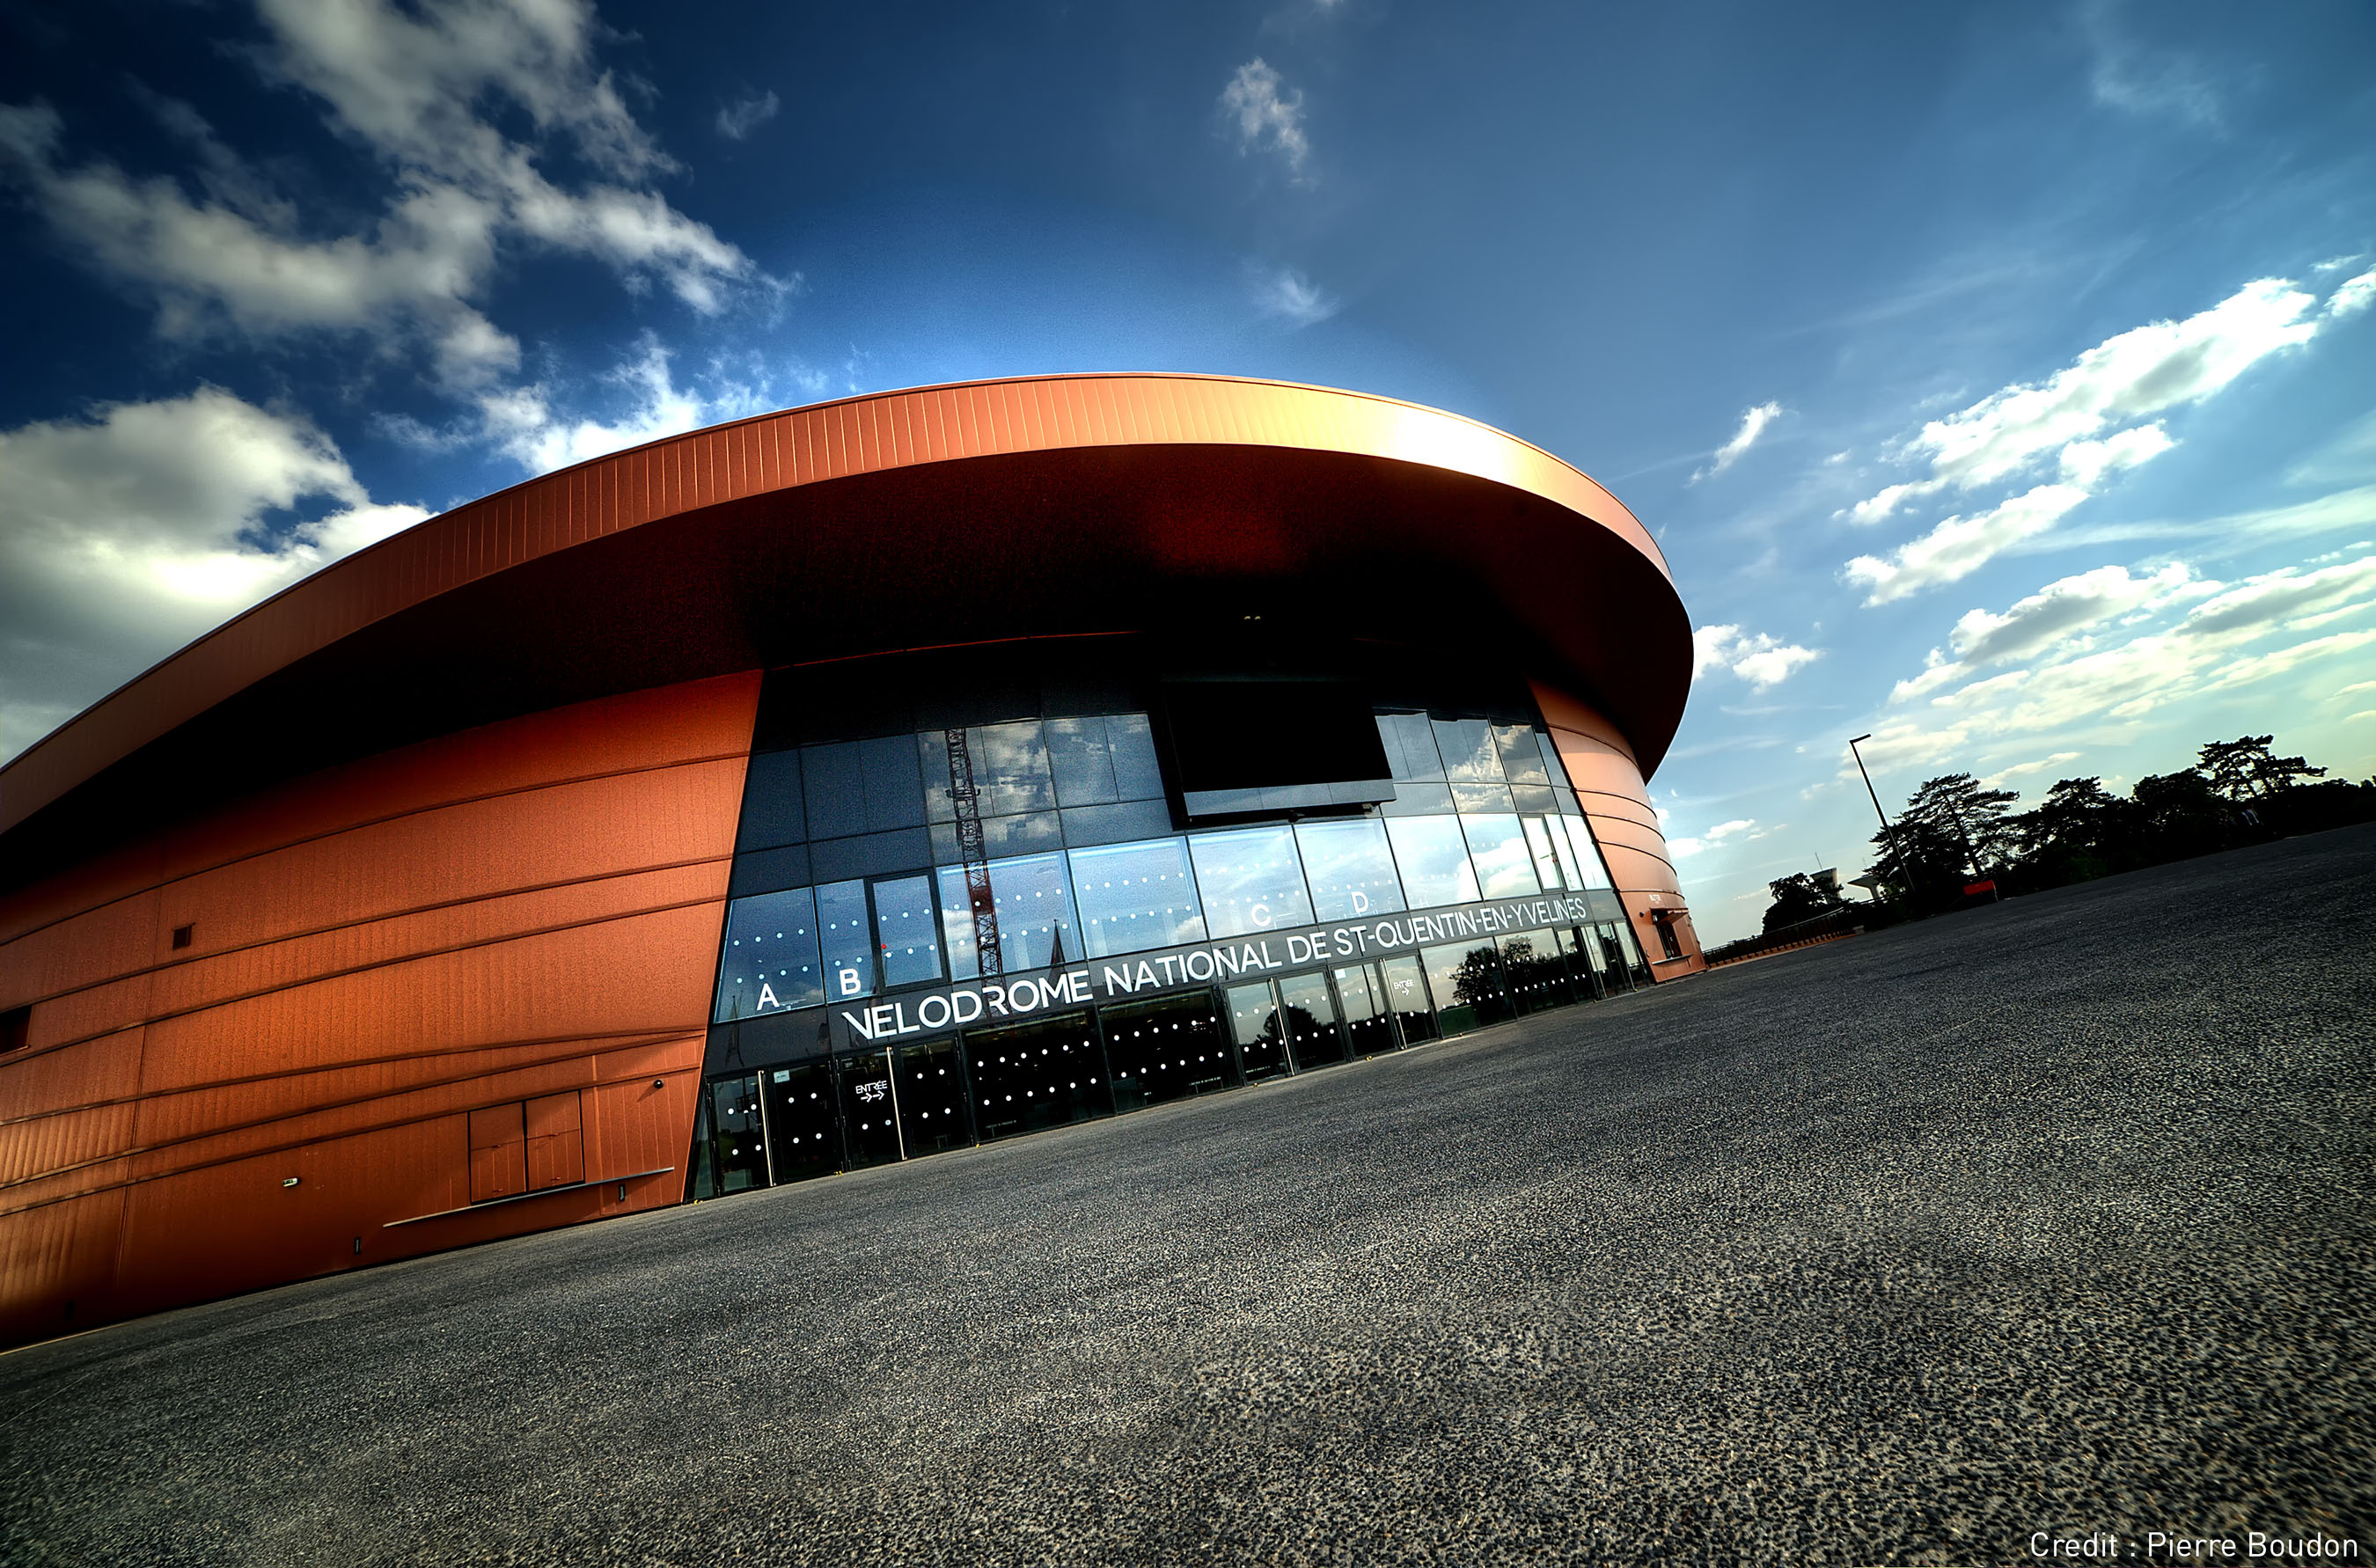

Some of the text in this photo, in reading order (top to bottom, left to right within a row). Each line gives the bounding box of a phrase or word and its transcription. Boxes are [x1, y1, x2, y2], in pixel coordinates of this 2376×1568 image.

[1250, 904, 1272, 927] C
[1351, 891, 1369, 913] D
[839, 968, 862, 996] B
[841, 898, 1587, 1040] VELODROME NATIONAL DE ST-QUENTIN-EN-YVELINES
[756, 983, 781, 1011] A
